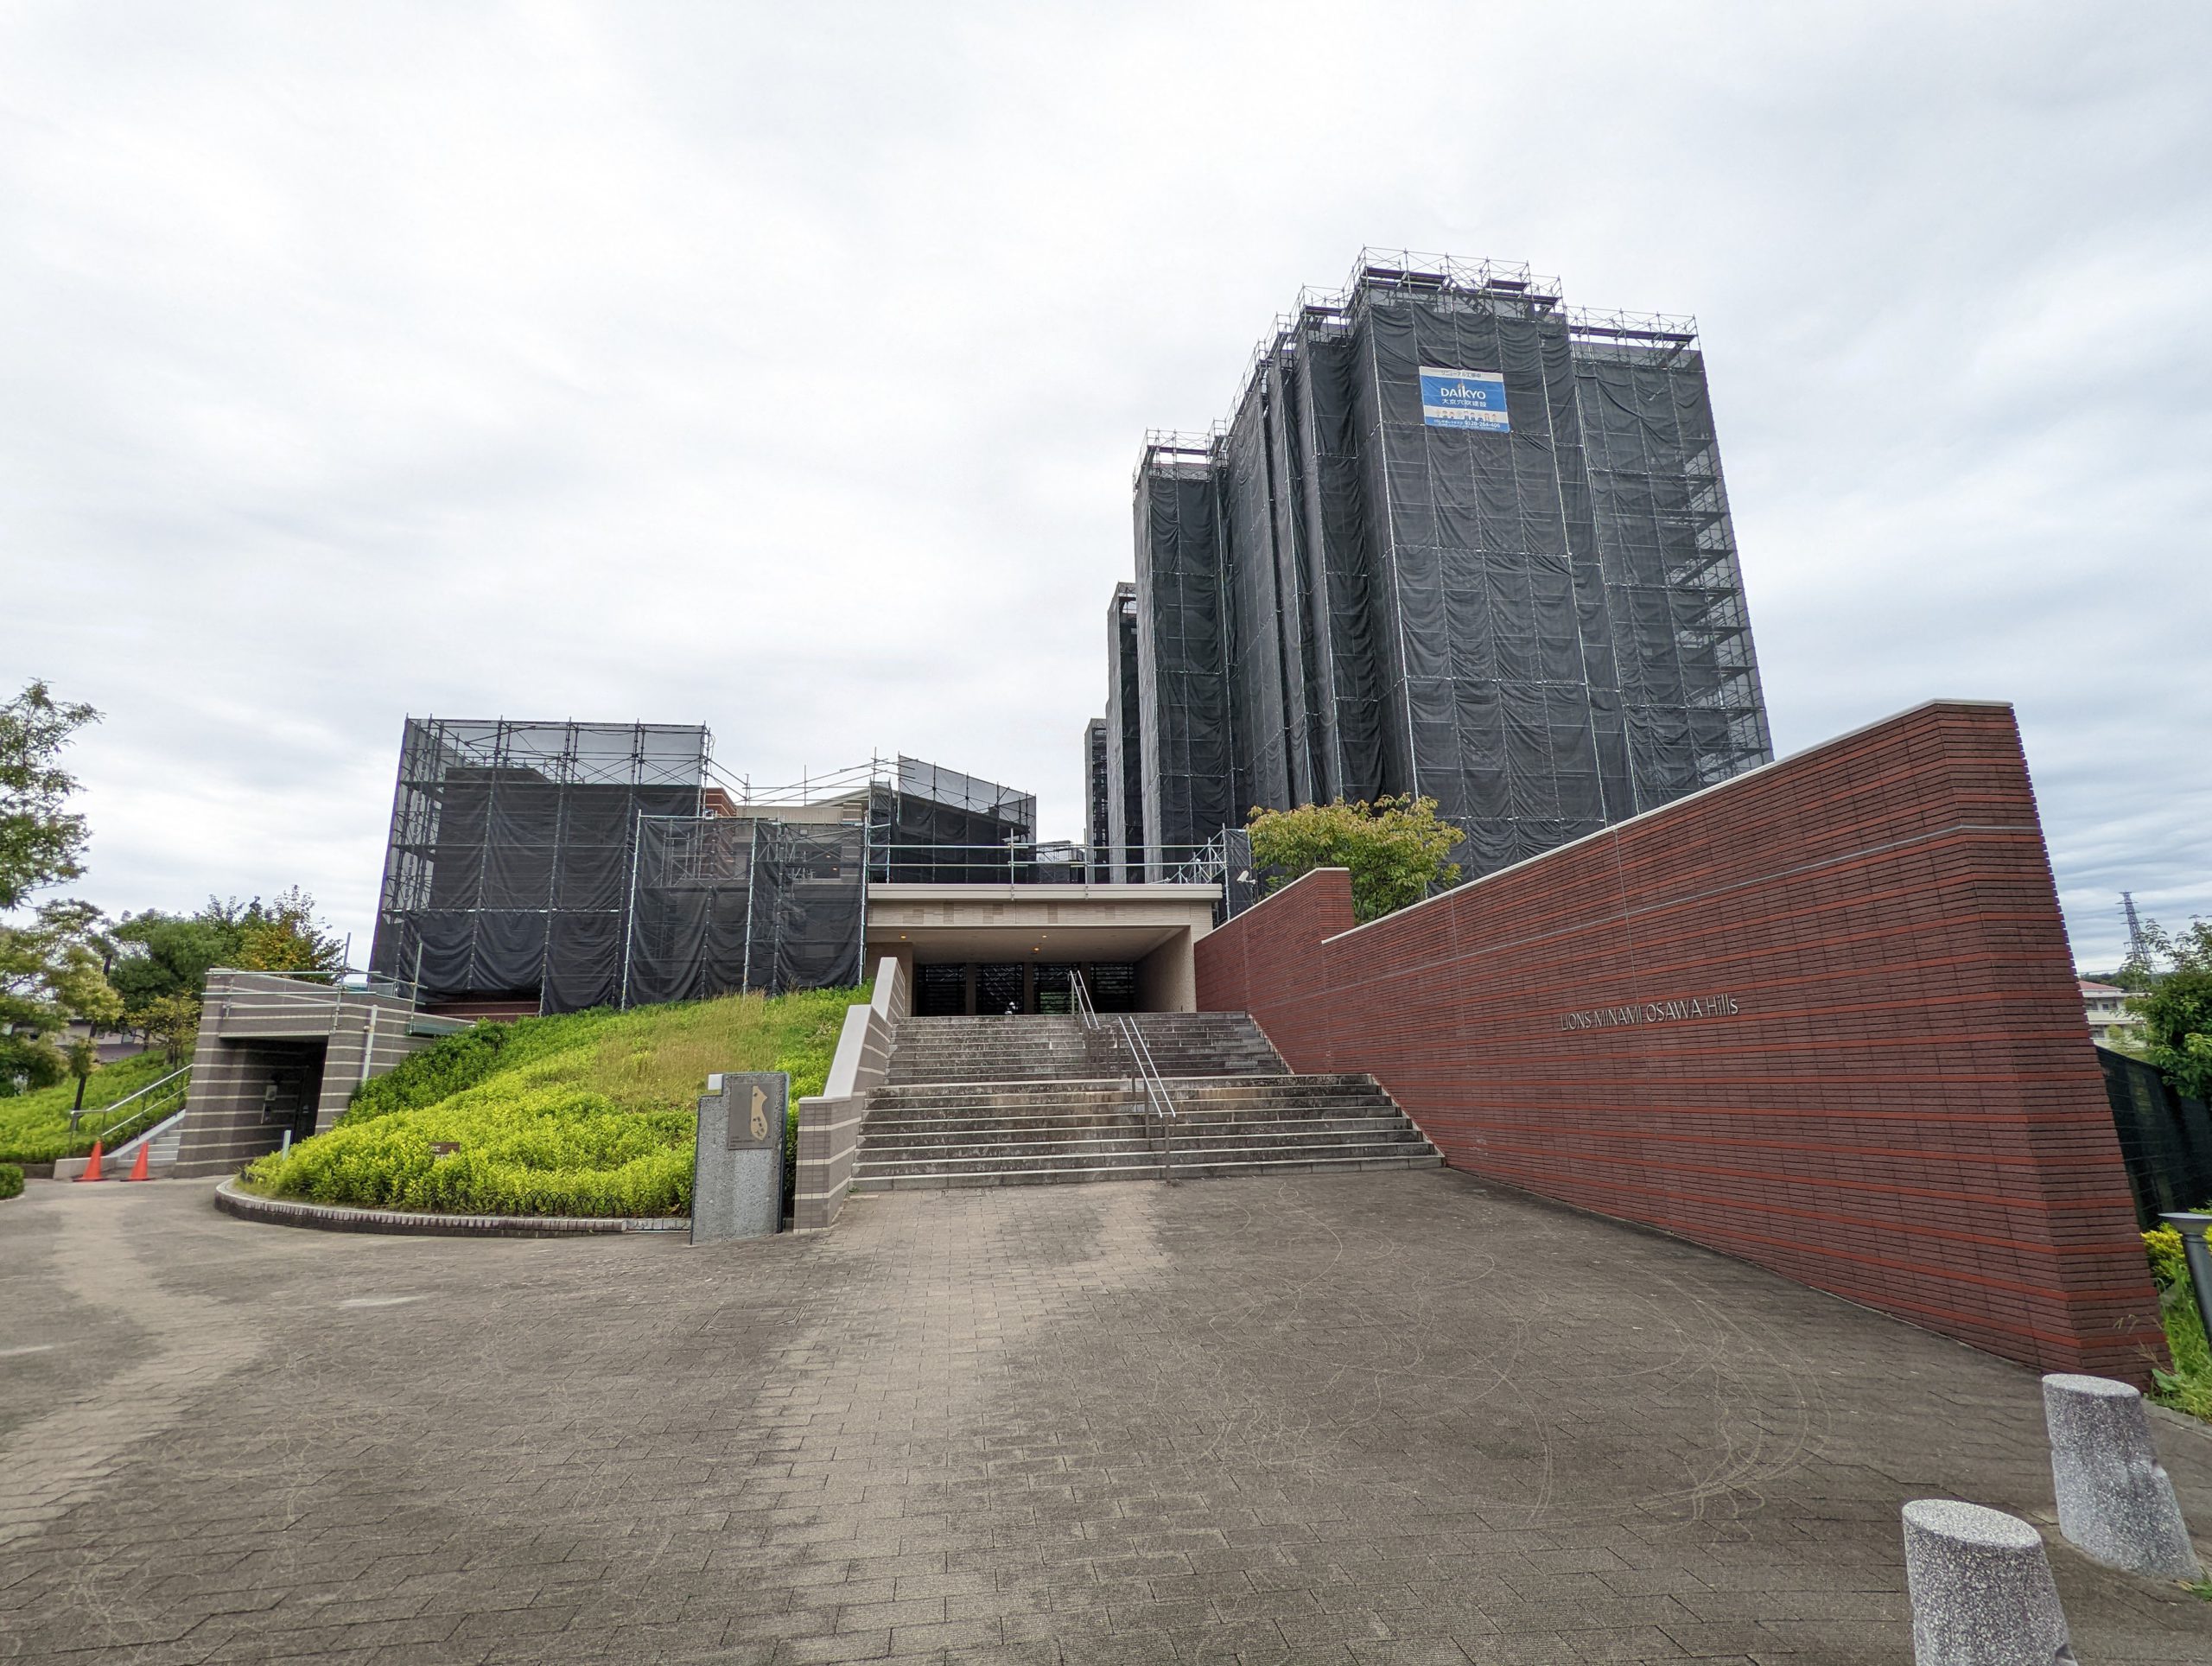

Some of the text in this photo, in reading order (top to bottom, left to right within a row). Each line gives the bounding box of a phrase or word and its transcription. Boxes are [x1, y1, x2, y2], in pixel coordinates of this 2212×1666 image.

[1441, 398, 1486, 408] 大京穴吹建設
[1560, 994, 1739, 1032] LIONS MINAMI OSAWA Hills
